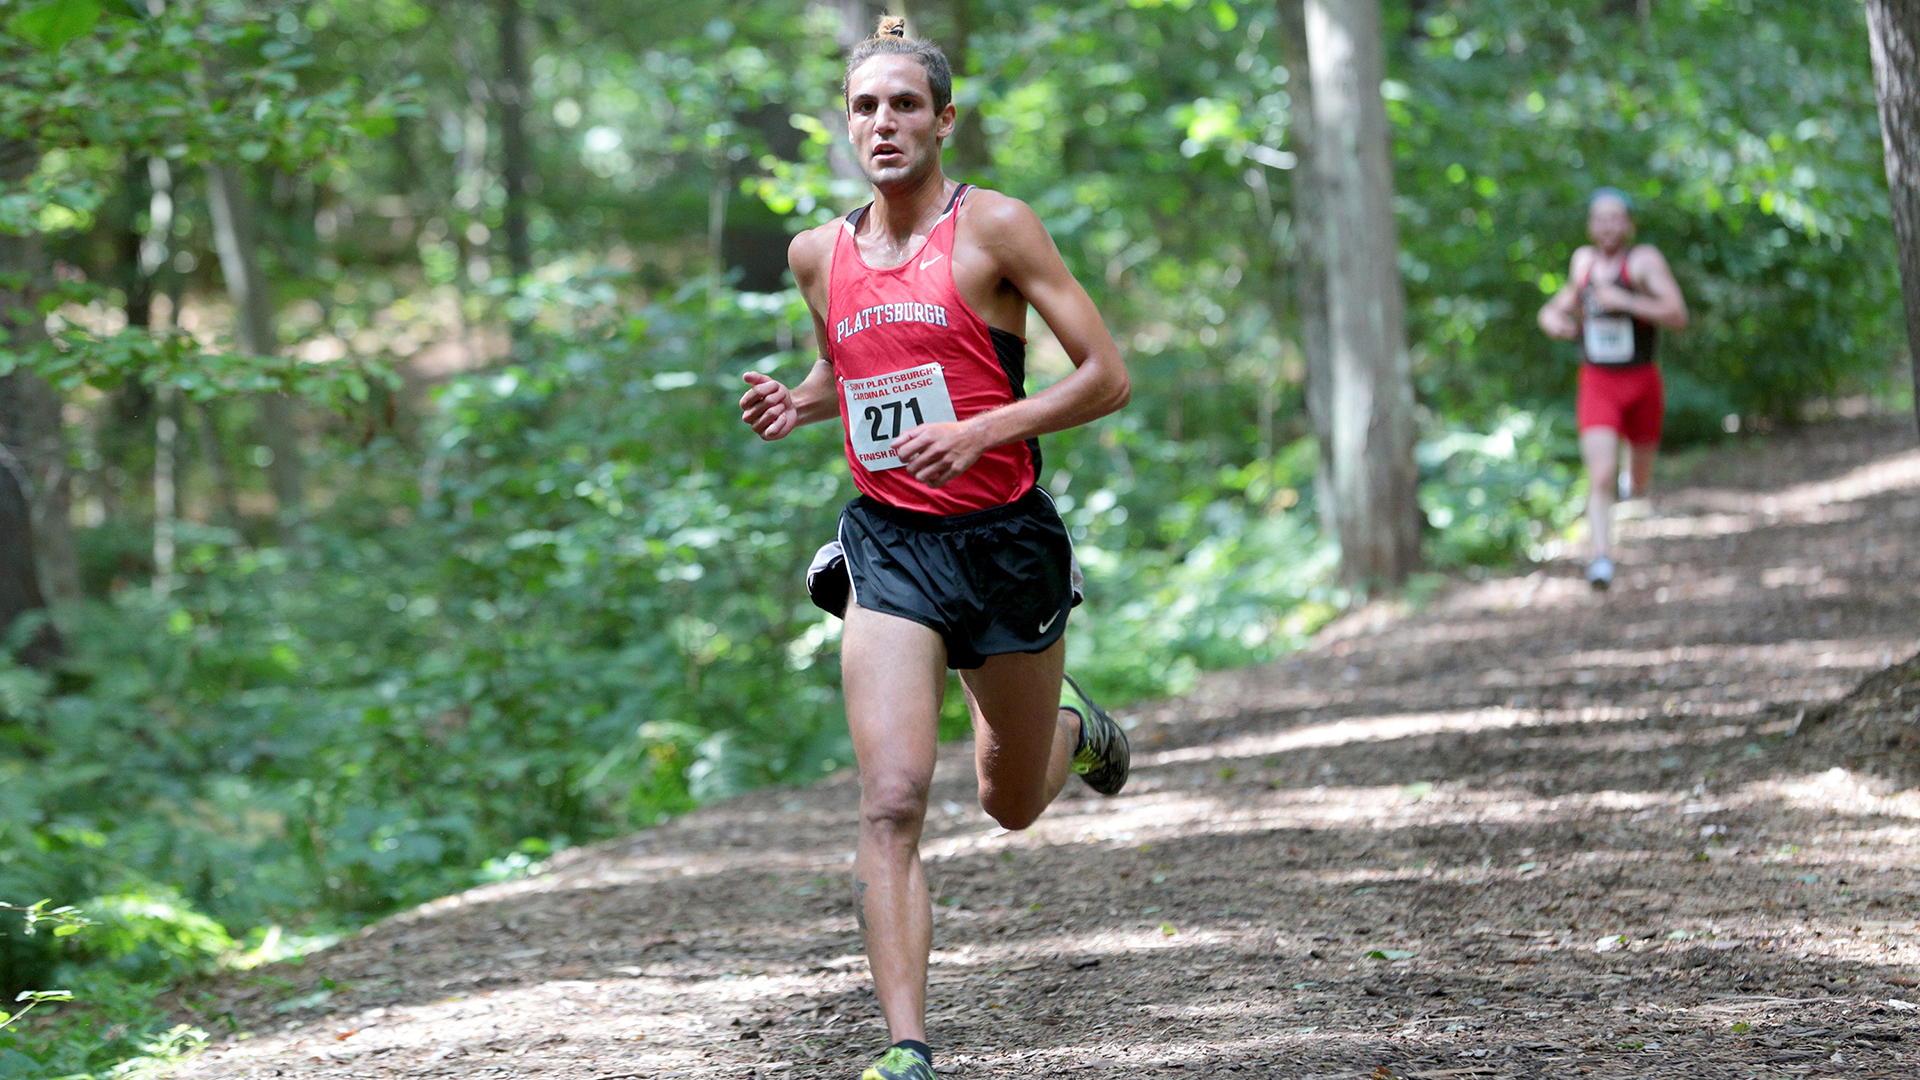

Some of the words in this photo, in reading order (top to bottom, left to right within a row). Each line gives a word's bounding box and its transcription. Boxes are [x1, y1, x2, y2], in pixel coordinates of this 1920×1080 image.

[836, 302, 948, 344] PLATTSBURGH
[849, 382, 865, 391] SUNY
[866, 367, 933, 389] PLATTSBURGH
[853, 388, 890, 401] CARDINAL
[892, 378, 933, 394] CLASSIC
[864, 397, 925, 442] 271
[859, 450, 888, 462] FINISH
